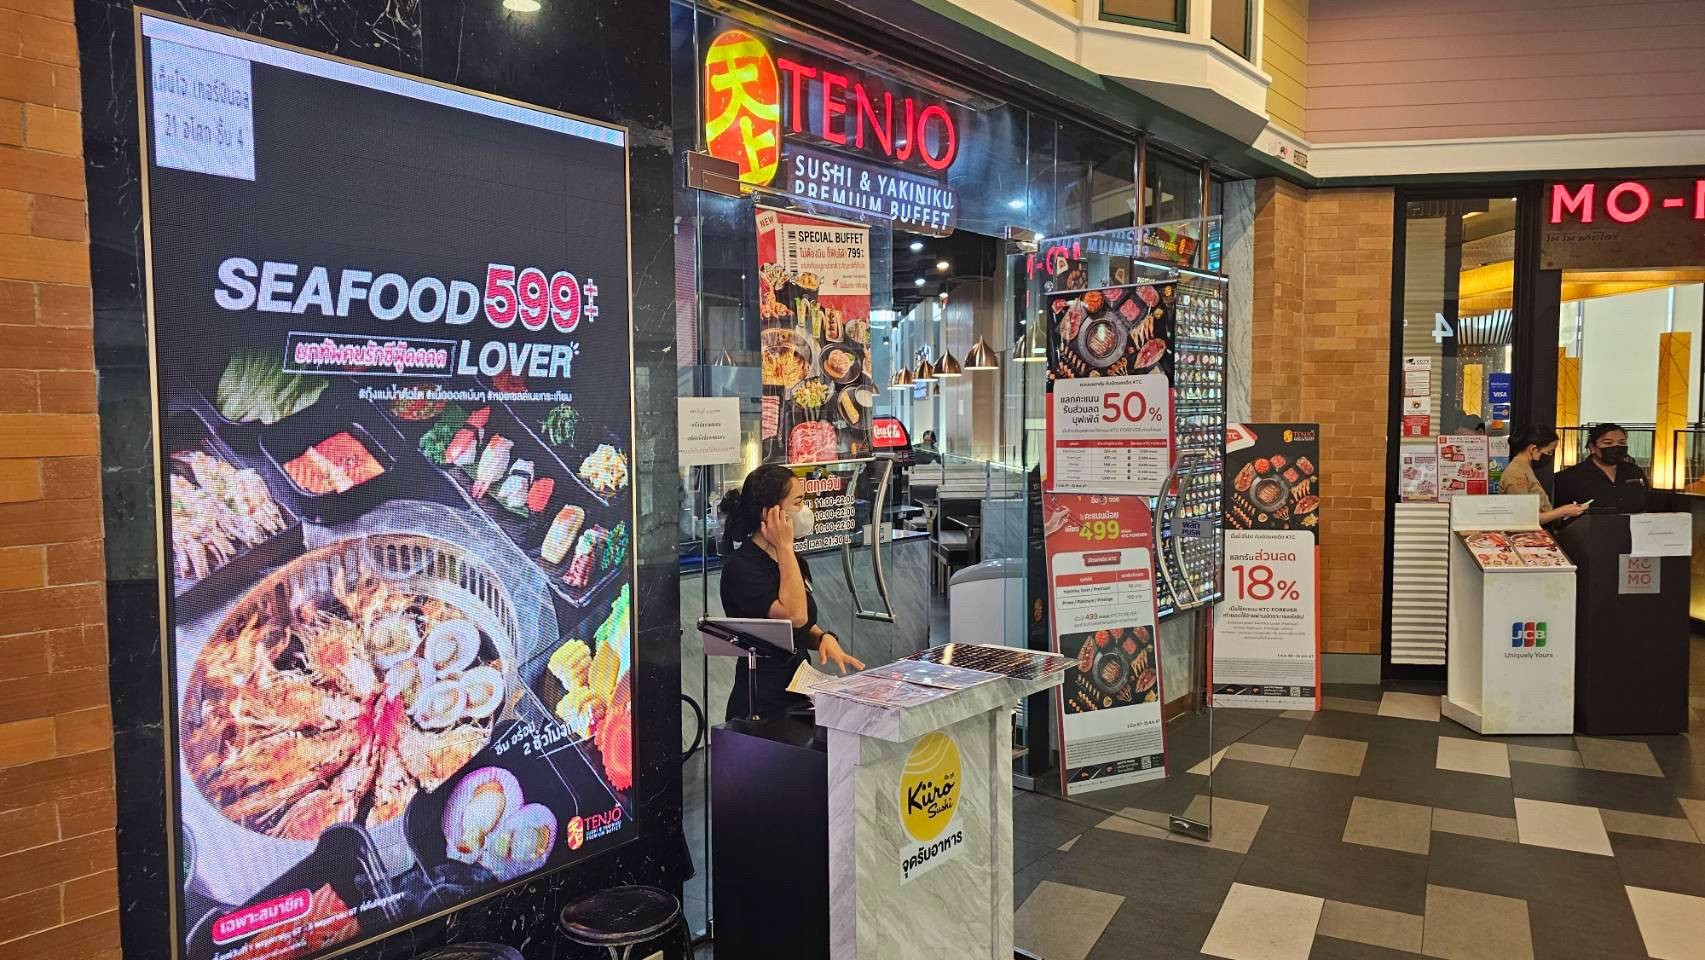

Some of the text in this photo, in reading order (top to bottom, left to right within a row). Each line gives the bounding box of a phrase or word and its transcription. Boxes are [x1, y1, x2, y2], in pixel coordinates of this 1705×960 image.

[777, 57, 956, 170] TENJO
[795, 155, 953, 208] SUSHI & YAKINIKU
[890, 201, 951, 230] BUFFET
[1551, 181, 1705, 224] MO-
[760, 216, 774, 228] NEW
[798, 231, 863, 244] SPECIAL BUFFET
[214, 256, 480, 326] SEAFOOD
[457, 340, 573, 378] LOVER
[1063, 404, 1099, 414] รับส่วนลด
[1079, 520, 1120, 541] 499
[1627, 574, 1651, 585] MO
[584, 807, 622, 831] TENJO
[927, 798, 953, 818] Sushi
[903, 831, 962, 878] จุดรับอาหาร
[219, 898, 304, 933] เฉพาะสมาชิก
